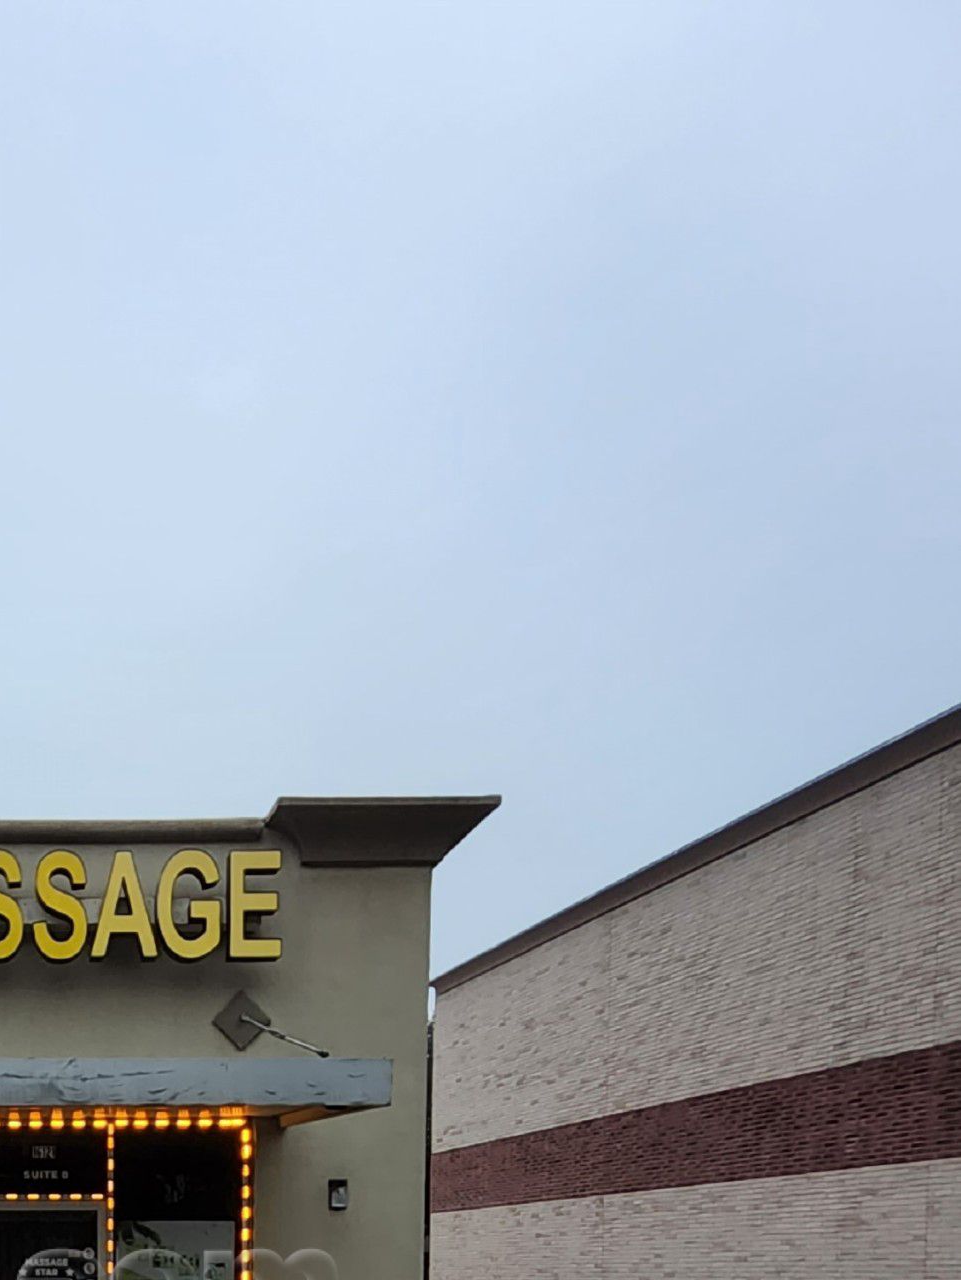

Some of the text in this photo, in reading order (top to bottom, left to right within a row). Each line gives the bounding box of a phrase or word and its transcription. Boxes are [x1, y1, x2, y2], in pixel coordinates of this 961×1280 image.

[23, 1170, 59, 1179] SUITE
[25, 1258, 69, 1267] MASSAGE
[34, 1268, 59, 1276] STAR
